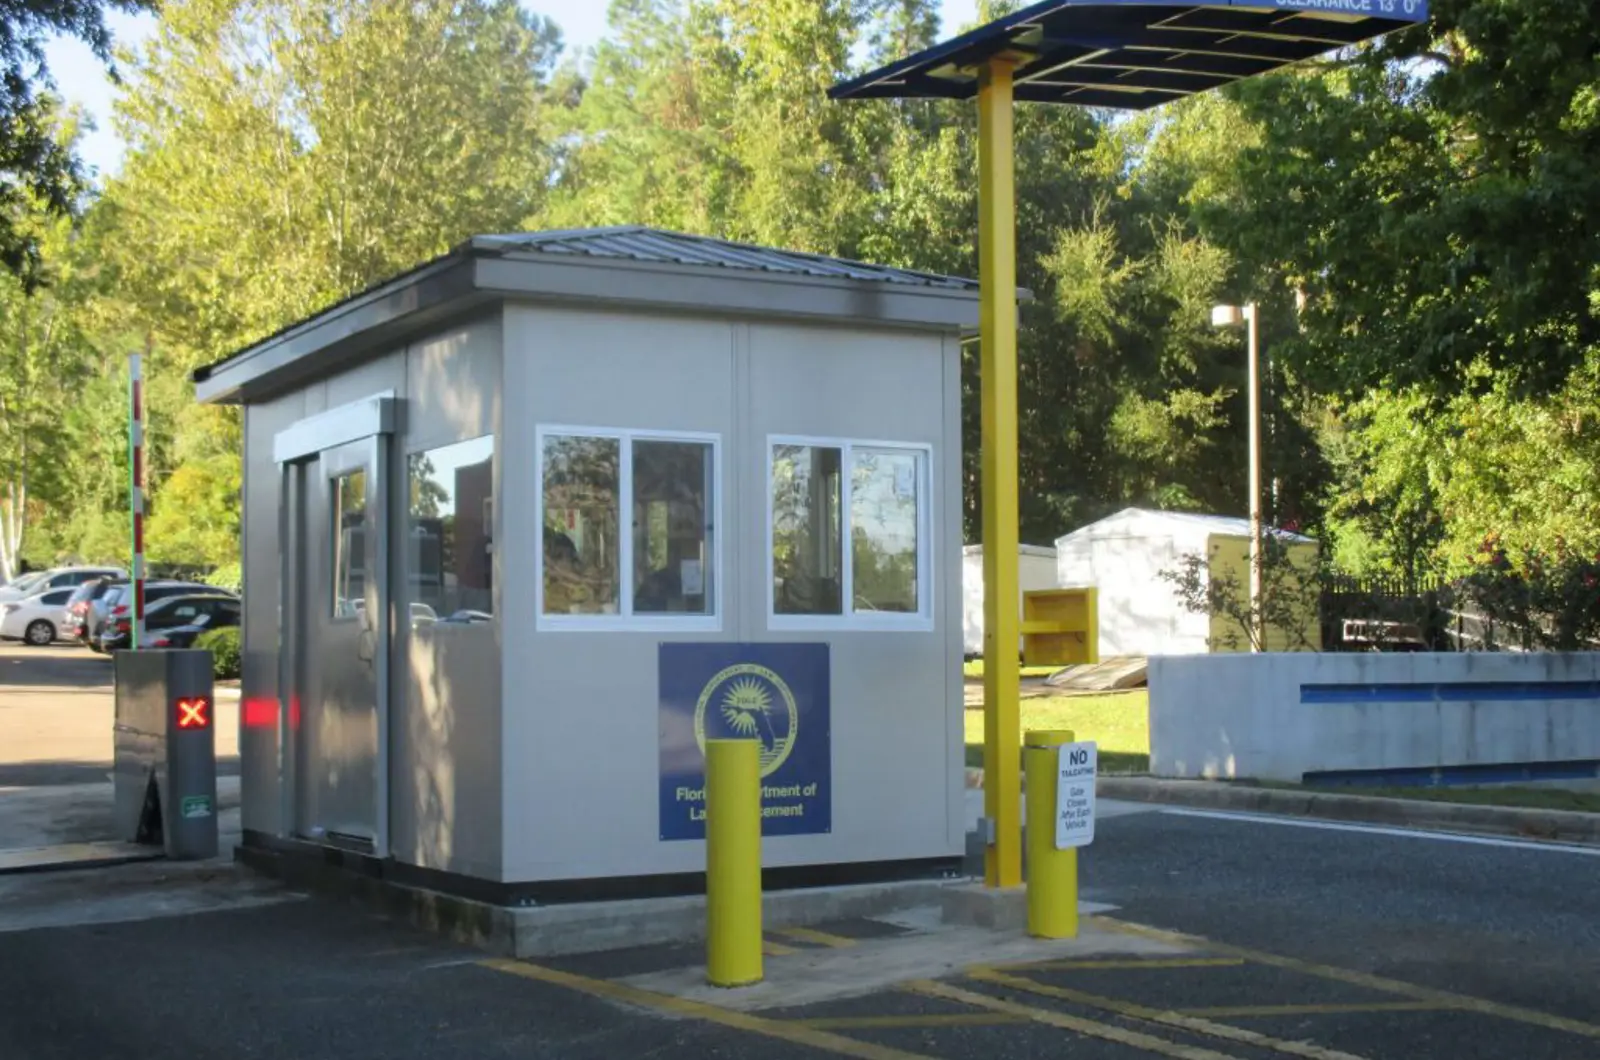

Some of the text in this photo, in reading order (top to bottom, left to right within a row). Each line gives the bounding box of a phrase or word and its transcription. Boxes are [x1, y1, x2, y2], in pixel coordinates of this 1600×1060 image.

[1069, 749, 1088, 766] NO
[676, 786, 706, 801] Flori
[803, 782, 817, 796] of
[690, 807, 707, 820] La
